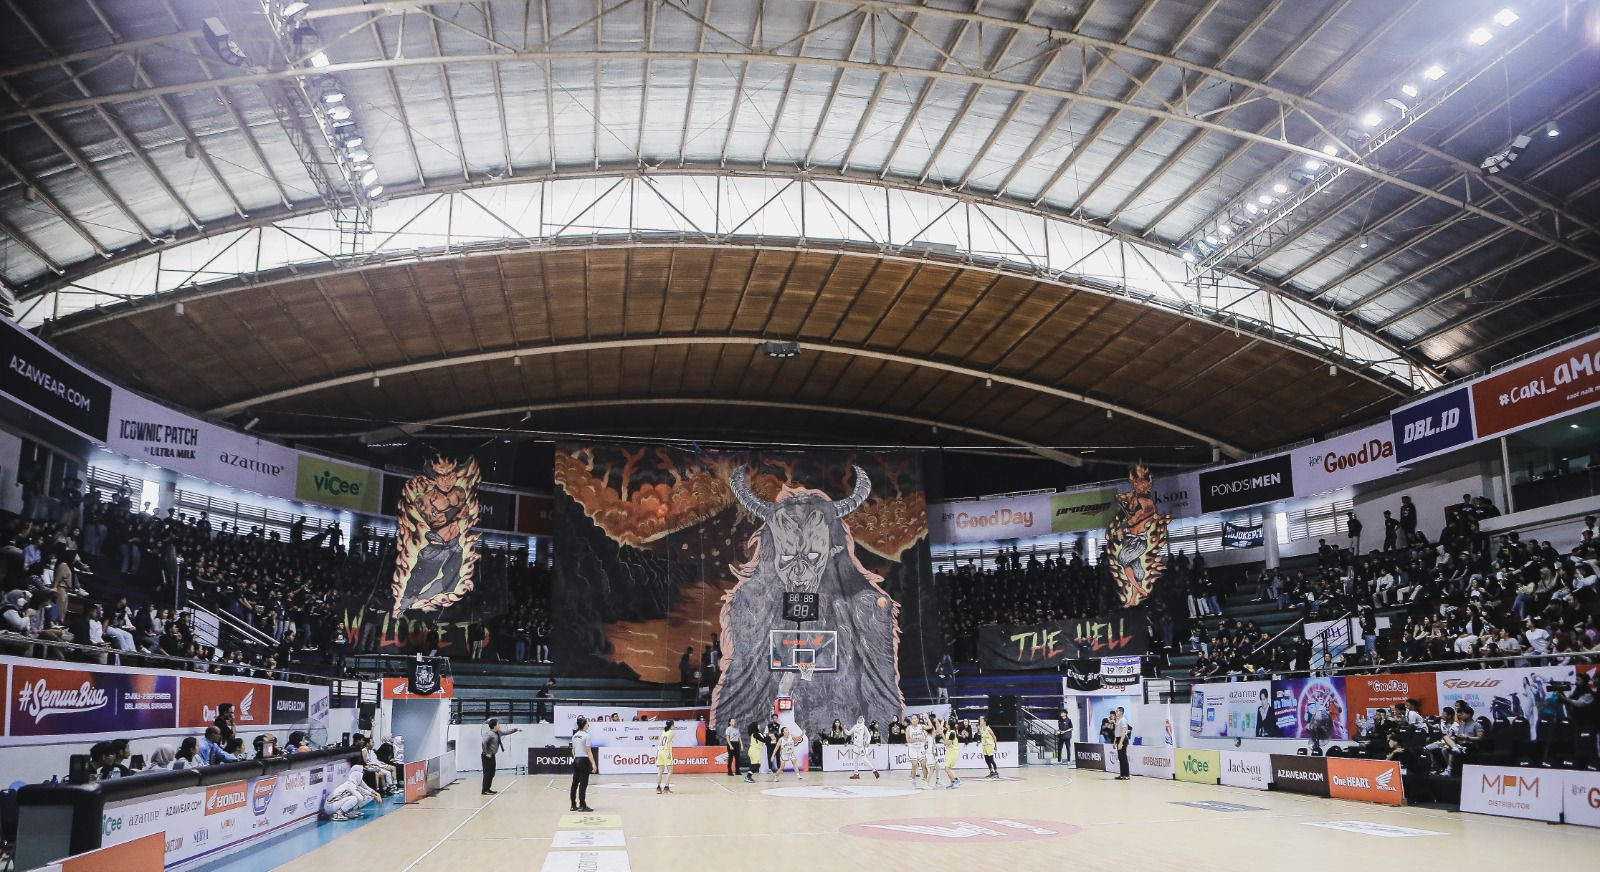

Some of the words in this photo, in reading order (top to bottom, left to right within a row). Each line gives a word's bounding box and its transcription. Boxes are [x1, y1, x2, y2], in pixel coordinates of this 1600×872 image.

[9, 354, 91, 412] AZAWEAR.COM
[1403, 407, 1460, 444] DBL.ID
[163, 425, 199, 446] PATCH
[175, 449, 197, 460] MILK
[1252, 472, 1282, 489] MEN
[1011, 629, 1064, 661] THE
[1073, 618, 1133, 651] HELL
[19, 678, 108, 722] #SemuaBisa
[1227, 759, 1261, 775] Jackson
[1277, 769, 1324, 782] AZAWEAR.COM
[1333, 775, 1346, 786] One
[216, 791, 246, 808] HONDA
[1488, 799, 1530, 810] DISTRIBUTOR
